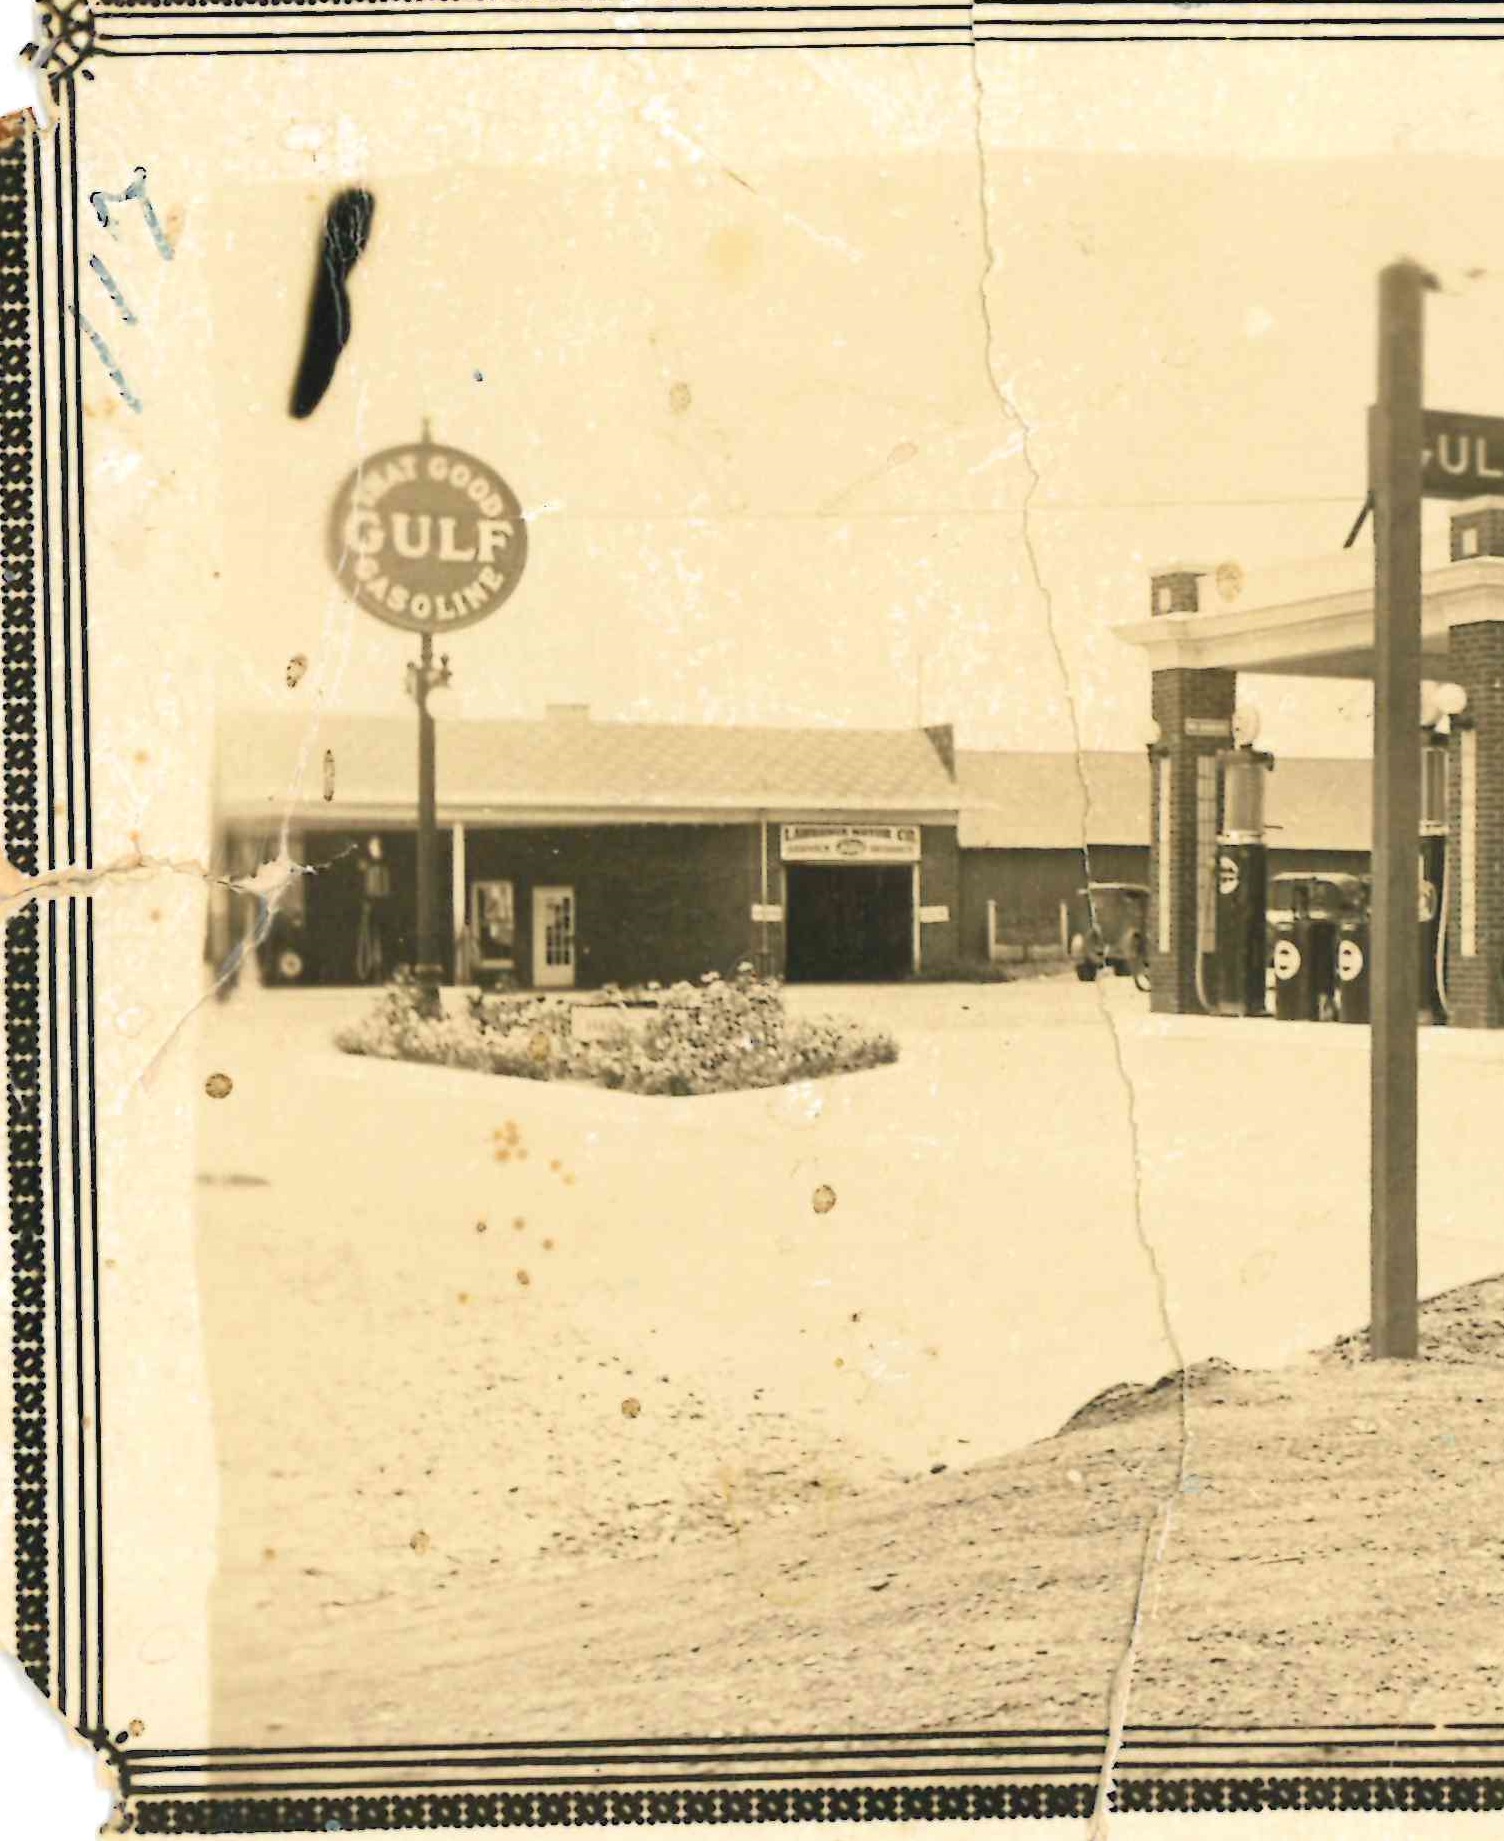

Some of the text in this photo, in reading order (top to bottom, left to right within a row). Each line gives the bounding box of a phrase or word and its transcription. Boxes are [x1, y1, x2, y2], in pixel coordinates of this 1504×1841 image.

[428, 455, 503, 518] GOOD
[345, 509, 514, 562] GULF
[354, 556, 504, 619] GASOLINE
